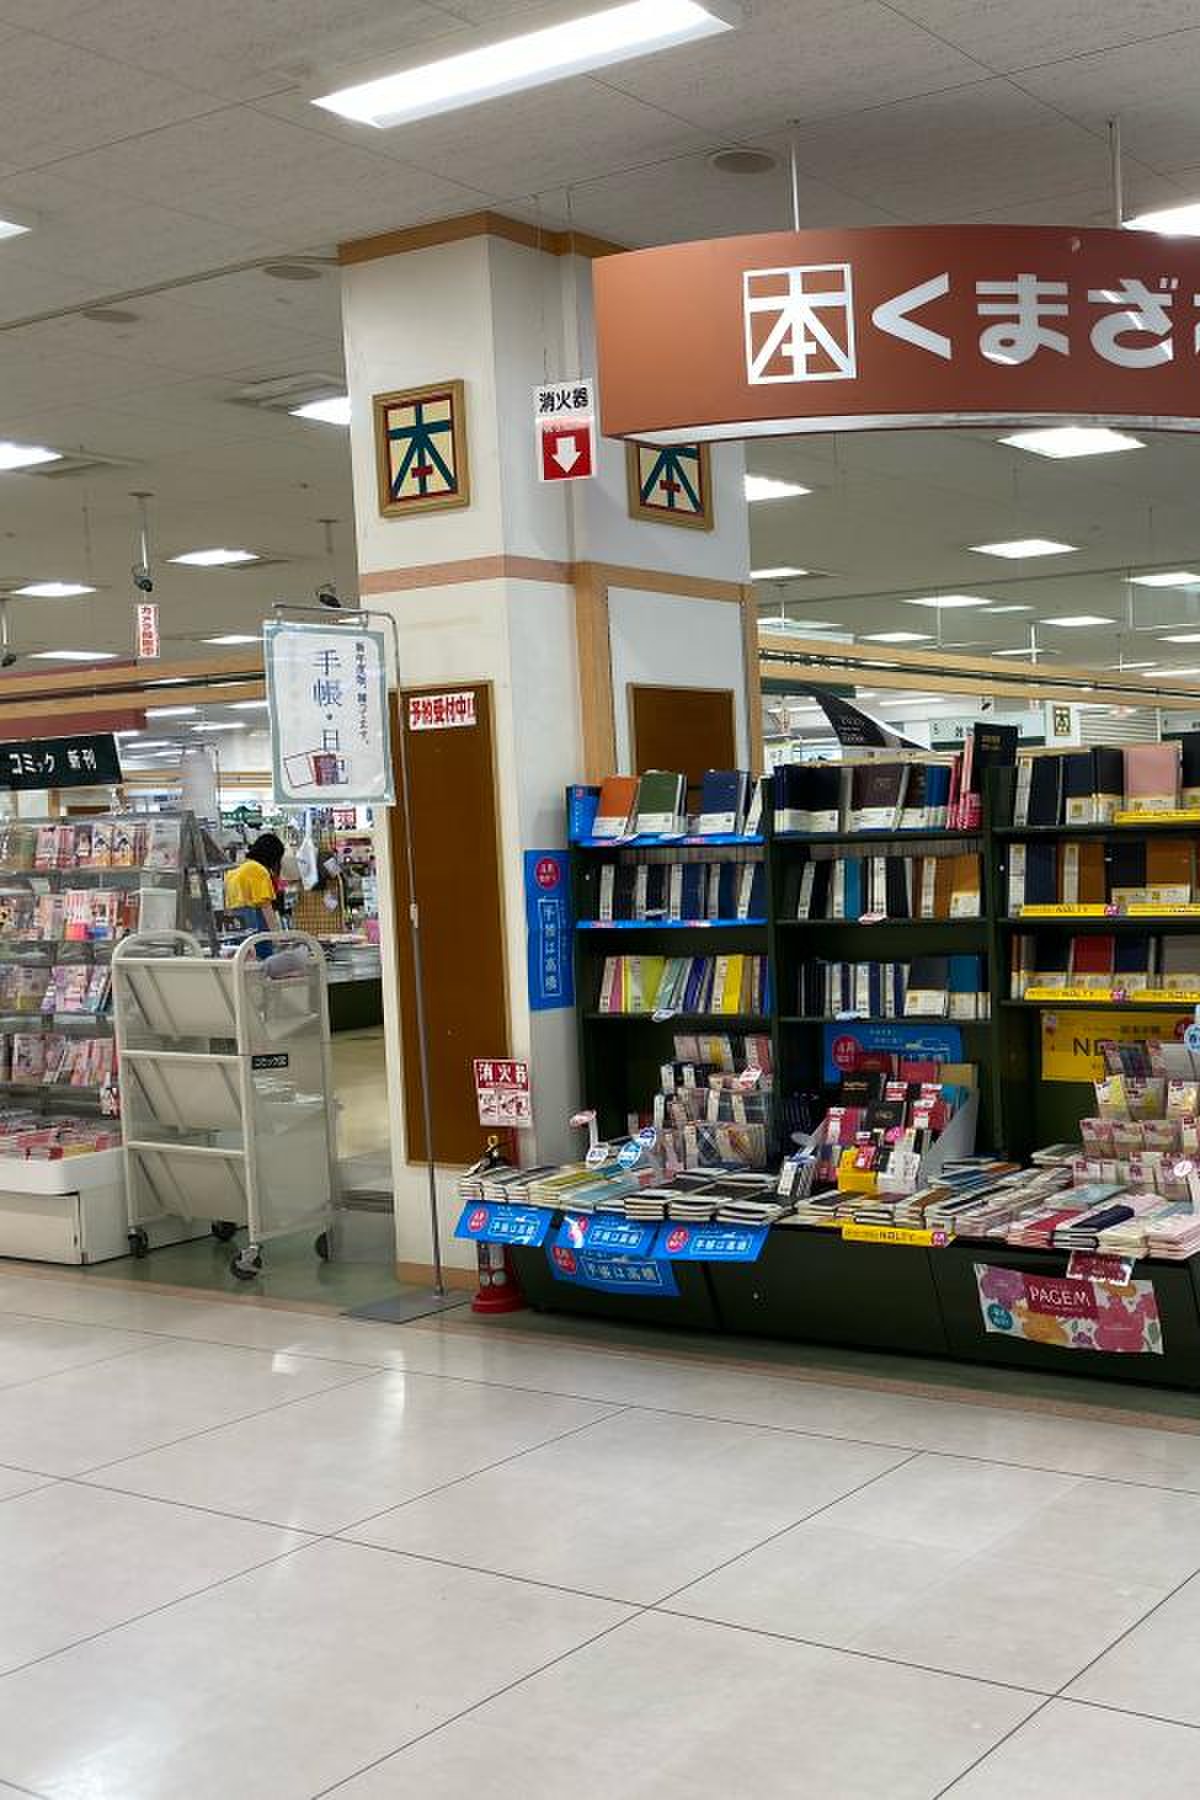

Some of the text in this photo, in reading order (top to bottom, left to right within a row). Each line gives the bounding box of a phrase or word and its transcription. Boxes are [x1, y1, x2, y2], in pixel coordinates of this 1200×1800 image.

[539, 387, 588, 413] 消火器
[9, 752, 56, 774] コミック
[479, 1063, 526, 1084] 消火器
